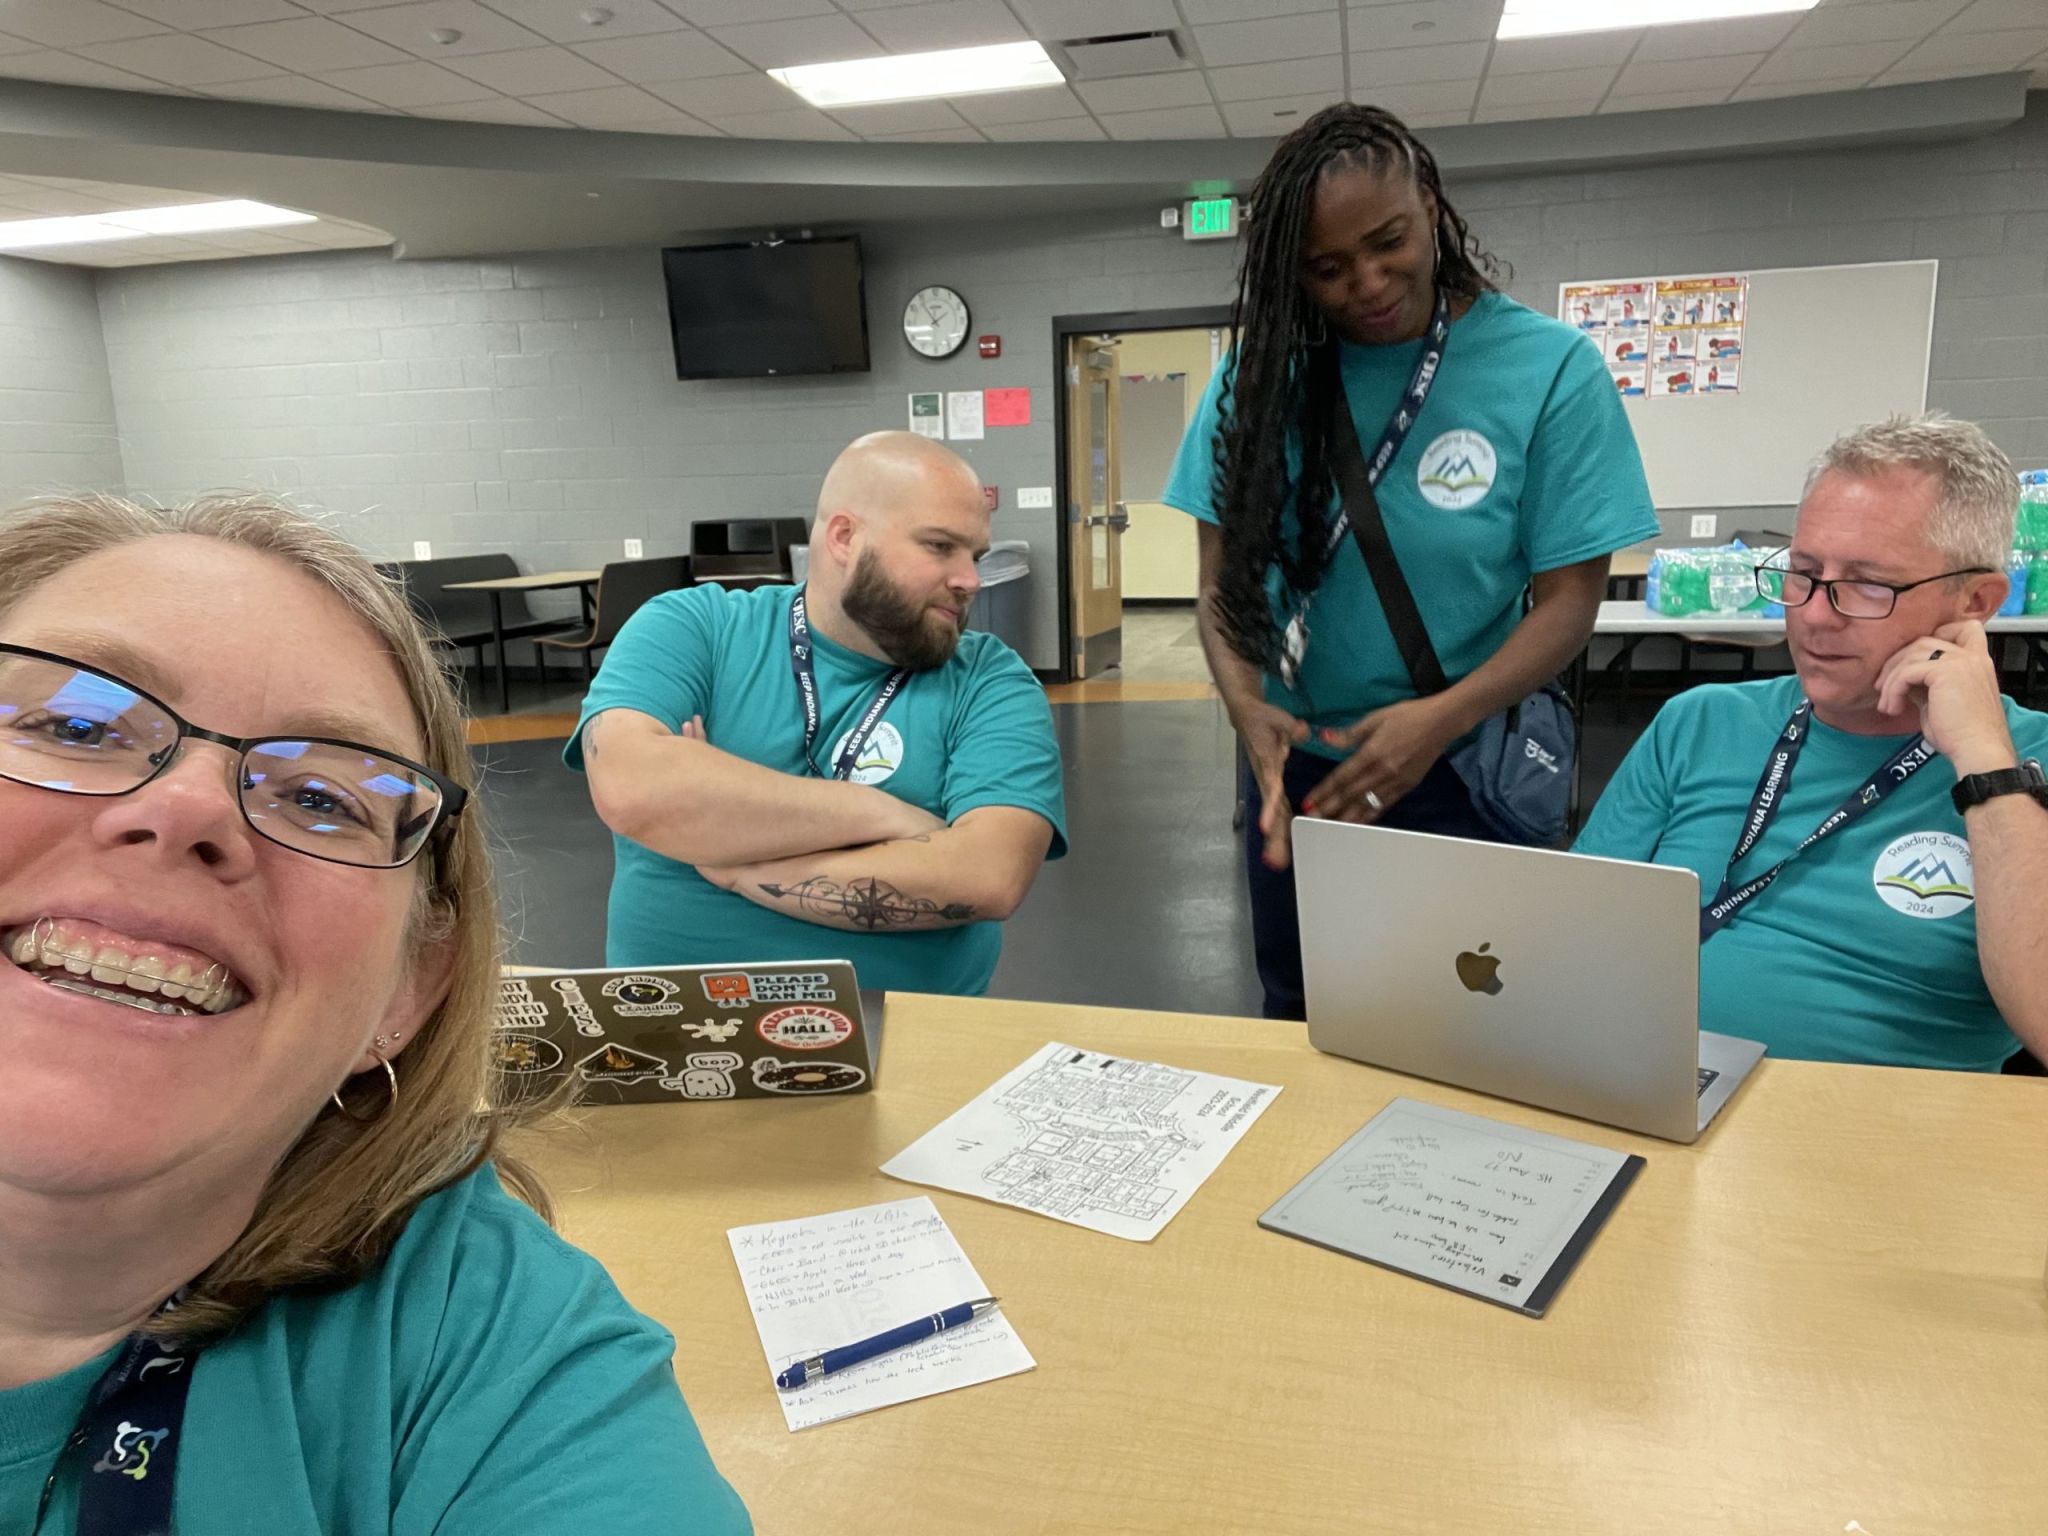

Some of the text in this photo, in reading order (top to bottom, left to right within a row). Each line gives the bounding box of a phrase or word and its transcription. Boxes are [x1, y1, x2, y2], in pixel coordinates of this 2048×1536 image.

[1192, 199, 1232, 234] EXIT
[799, 671, 816, 732] KEEP INDIANA
[847, 732, 863, 755] KEEP
[860, 697, 888, 732] INDIANA
[1737, 752, 1788, 856] INDIANA LEARNING
[1818, 810, 1848, 835] KEEP
[1887, 835, 1937, 857] Reading
[1711, 876, 1771, 919] LEARNING
[1905, 902, 1934, 915] 2024
[753, 975, 825, 984] PLEASE
[755, 984, 812, 992] DON'T
[757, 991, 833, 1001] BAN ME!
[522, 1005, 543, 1015] FU
[783, 1024, 831, 1034] HALL
[698, 1058, 731, 1066] boo
